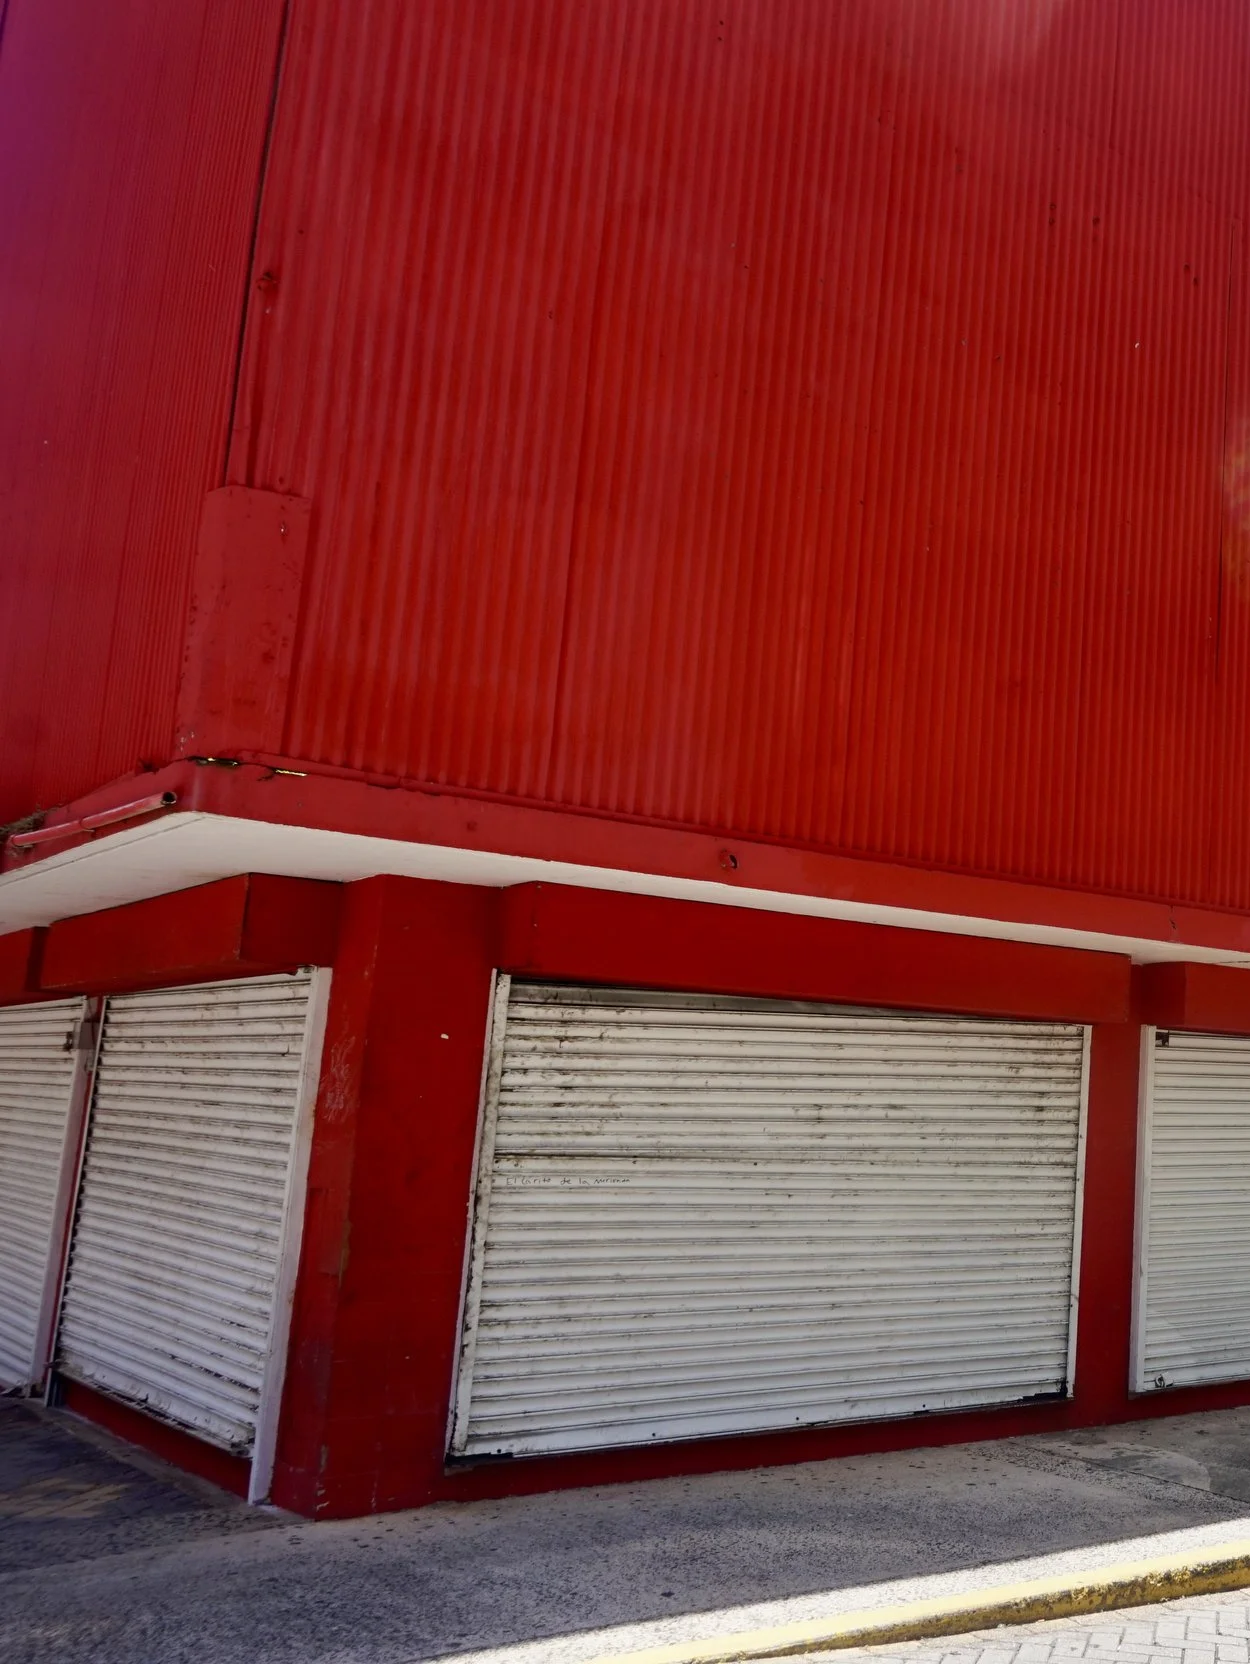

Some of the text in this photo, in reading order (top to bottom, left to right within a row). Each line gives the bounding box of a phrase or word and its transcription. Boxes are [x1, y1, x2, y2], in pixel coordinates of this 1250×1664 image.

[506, 1177, 517, 1186] El
[560, 1177, 572, 1186] de
[579, 1177, 591, 1186] la
